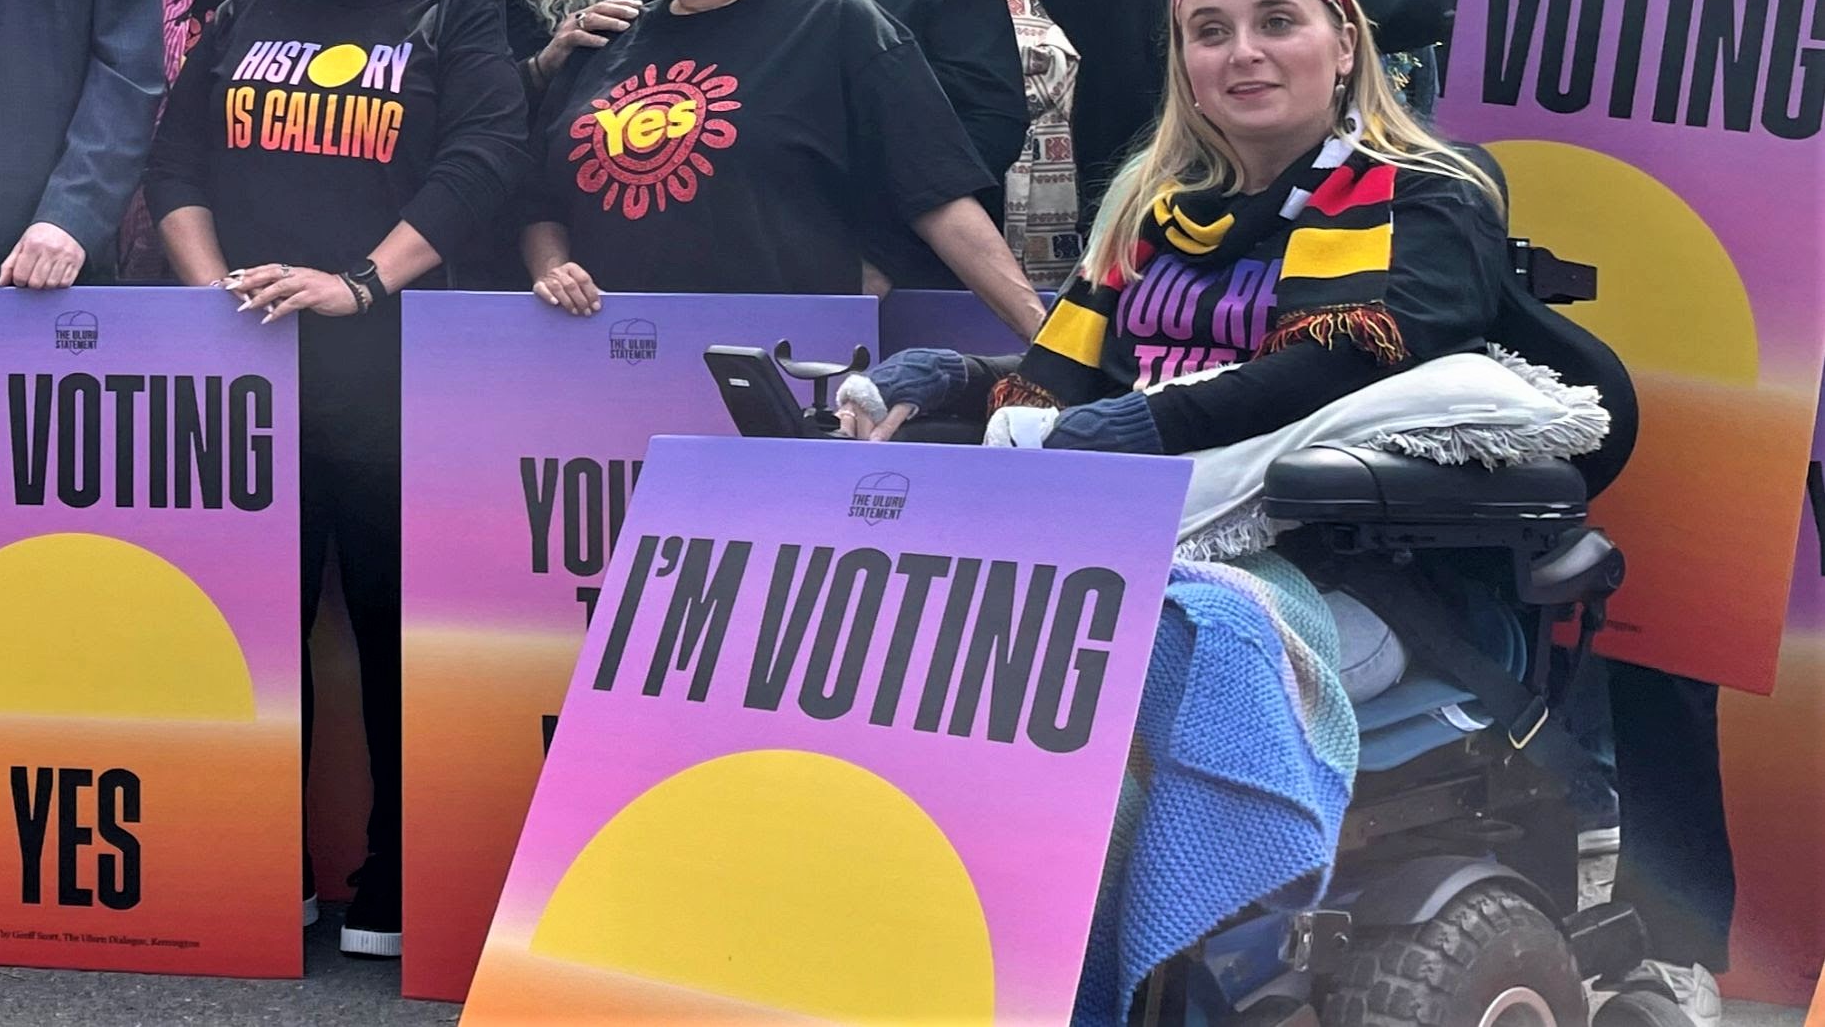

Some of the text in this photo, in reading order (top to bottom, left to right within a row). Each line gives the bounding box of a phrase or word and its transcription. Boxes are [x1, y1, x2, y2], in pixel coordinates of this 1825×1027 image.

[226, 86, 405, 164] IS CALLING
[594, 99, 698, 157] Yes
[8, 373, 274, 512] VOTING
[853, 493, 872, 507] THE
[592, 534, 1127, 753] I'M VOTING
[10, 765, 141, 911] YES
